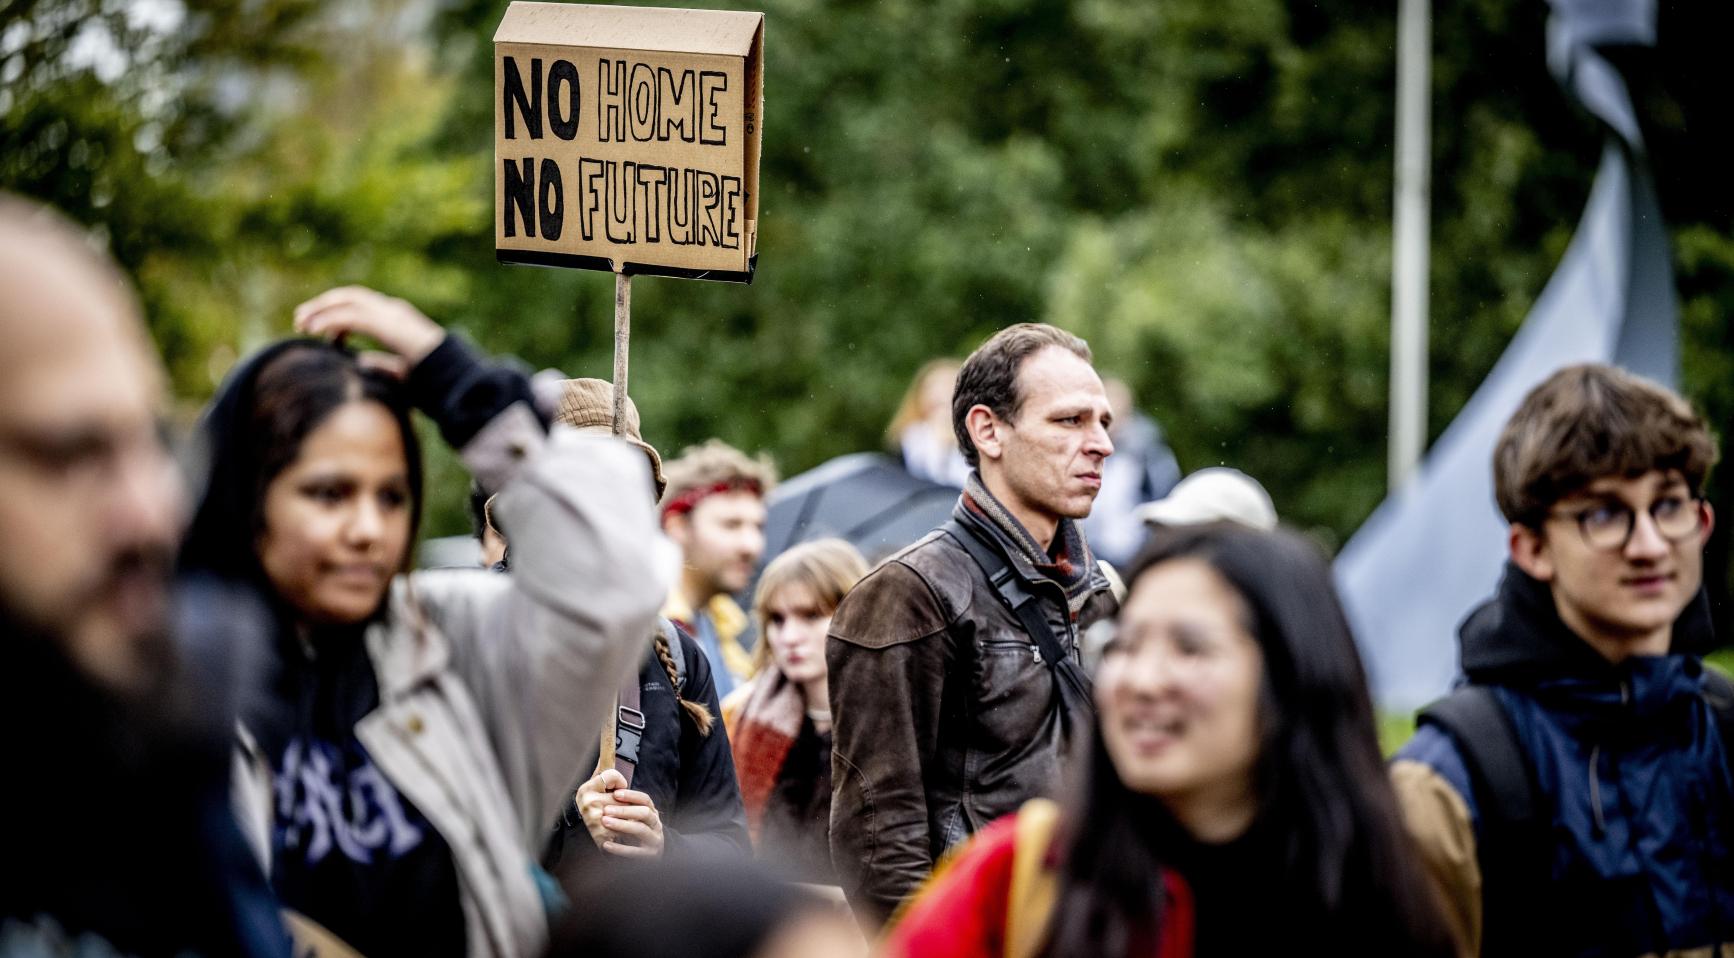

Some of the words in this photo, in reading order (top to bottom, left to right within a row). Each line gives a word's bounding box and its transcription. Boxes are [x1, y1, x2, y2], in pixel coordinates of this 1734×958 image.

[503, 56, 581, 140] NO
[598, 58, 728, 146] HOME
[503, 157, 564, 241] NO
[578, 157, 741, 250] FUTURE
